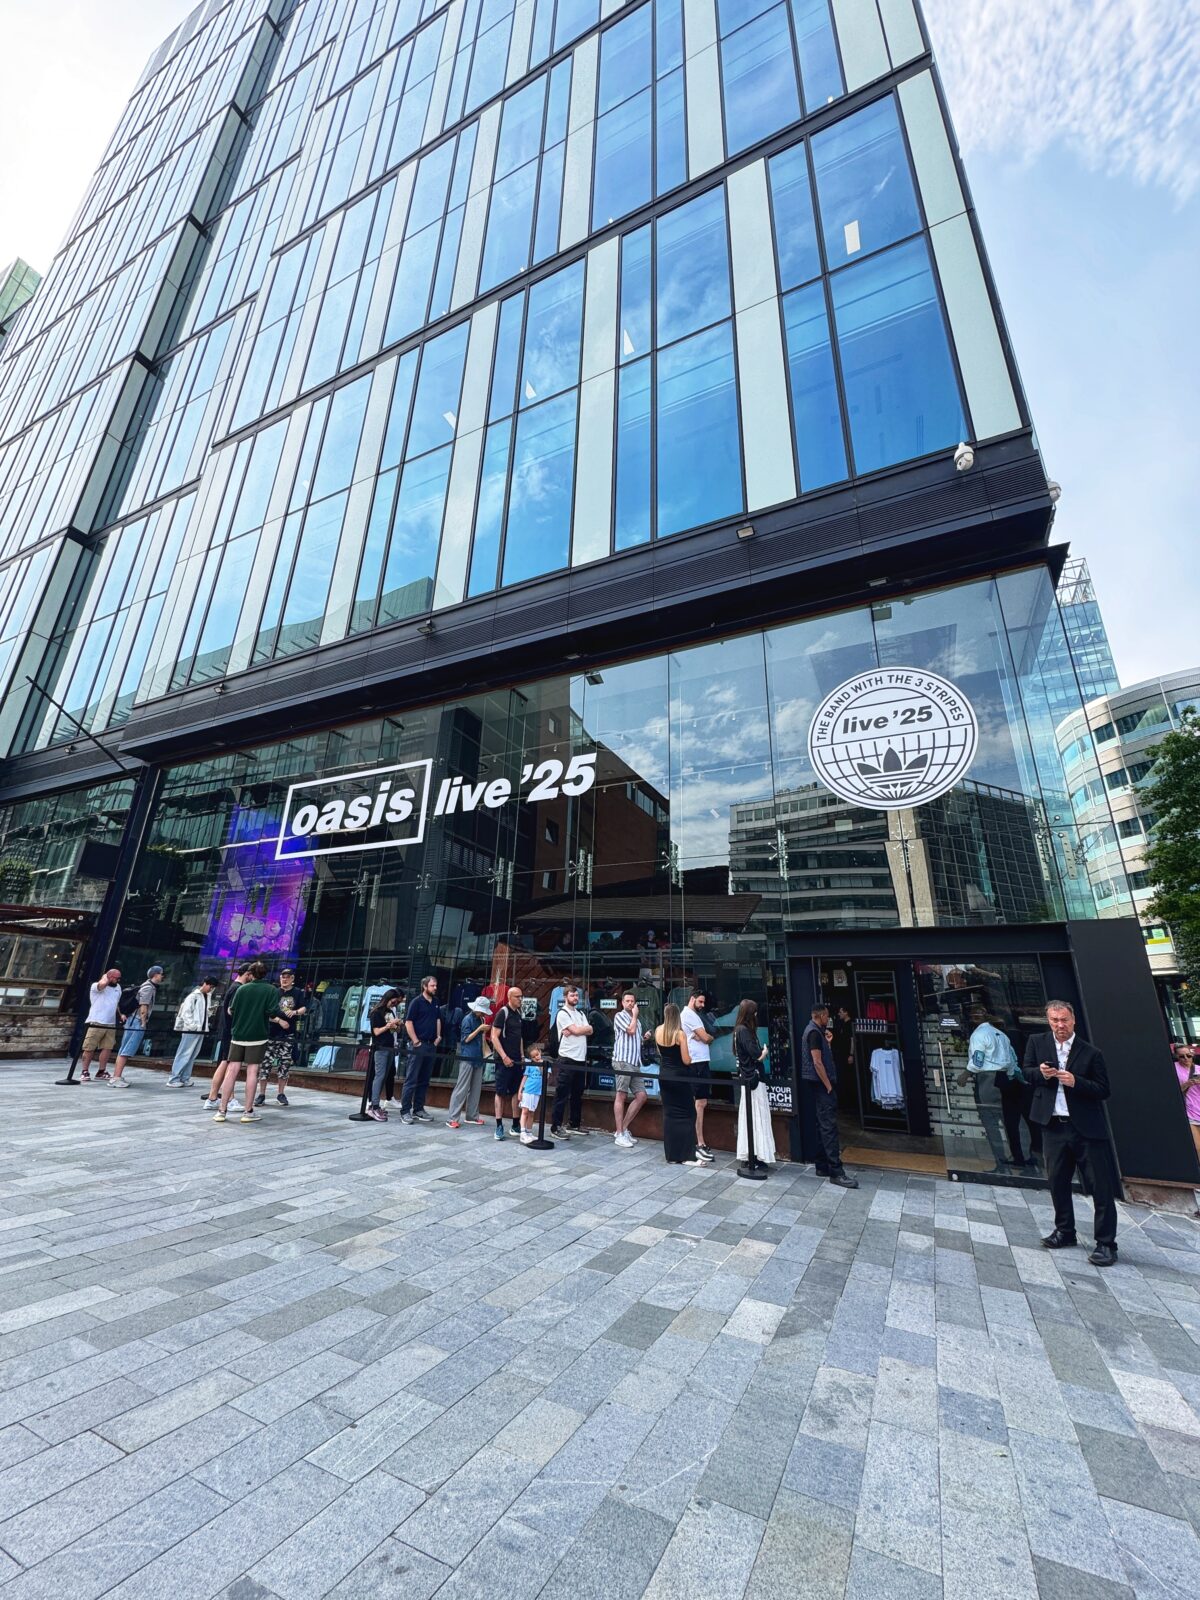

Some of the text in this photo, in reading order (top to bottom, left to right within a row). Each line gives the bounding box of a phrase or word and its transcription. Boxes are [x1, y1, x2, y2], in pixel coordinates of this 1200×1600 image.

[817, 674, 965, 742] THE BAND WITH THE 3 STRIPES
[842, 705, 933, 734] live '25
[291, 752, 597, 836] oasis live '25
[768, 1092, 792, 1103] RCH
[770, 1085, 792, 1094] YOUR
